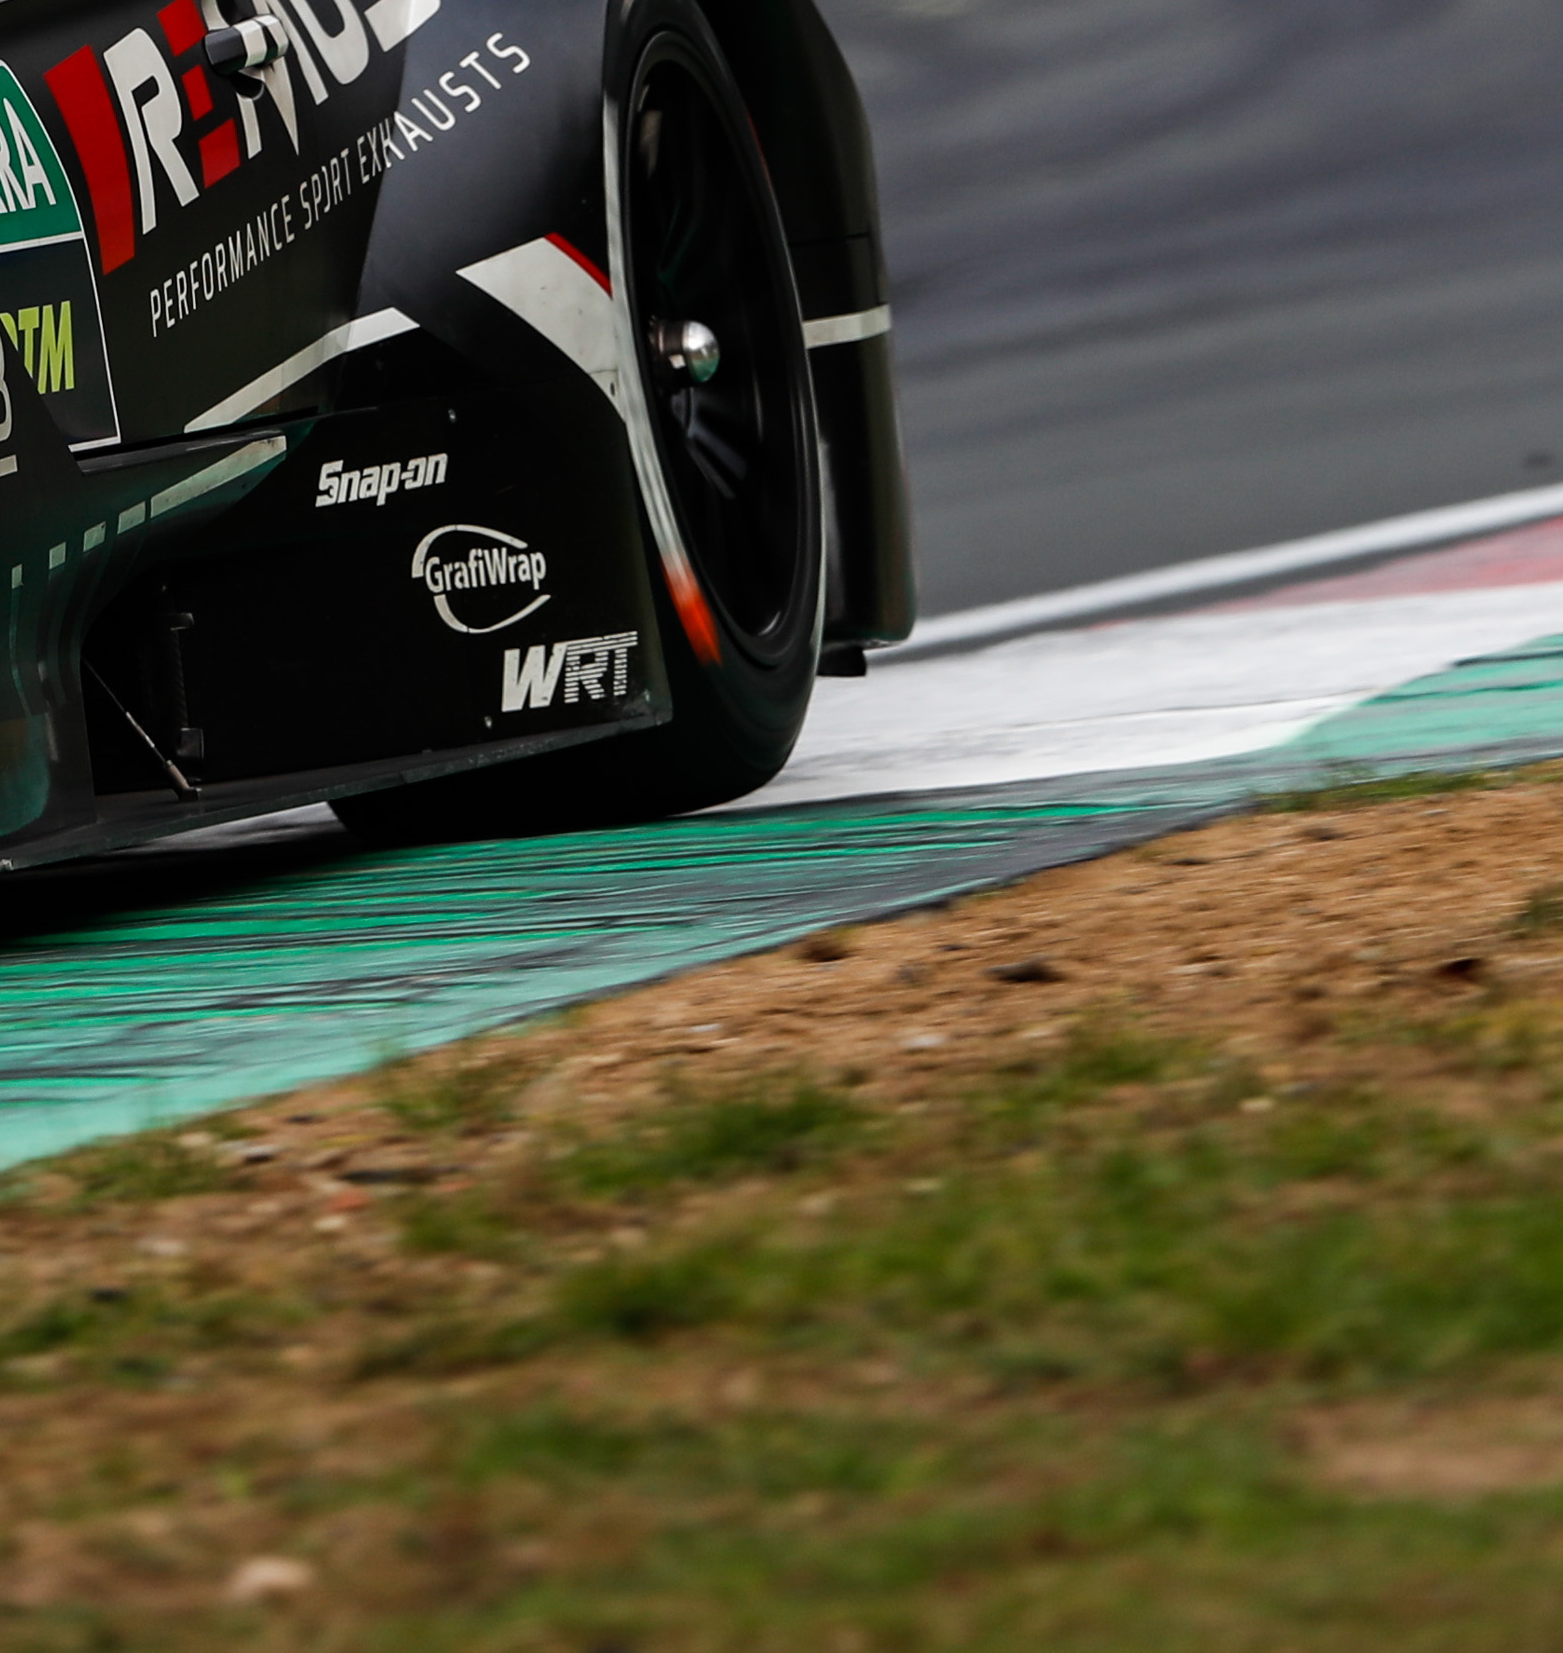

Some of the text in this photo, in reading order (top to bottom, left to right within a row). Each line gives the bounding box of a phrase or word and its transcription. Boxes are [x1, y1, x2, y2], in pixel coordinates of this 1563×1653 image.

[150, 194, 295, 337] PERFORMANCE
[357, 32, 531, 184] EXHAUSTS
[315, 452, 448, 507] Snap-on
[424, 545, 547, 596] GrafiWrap
[501, 630, 638, 713] WRT
